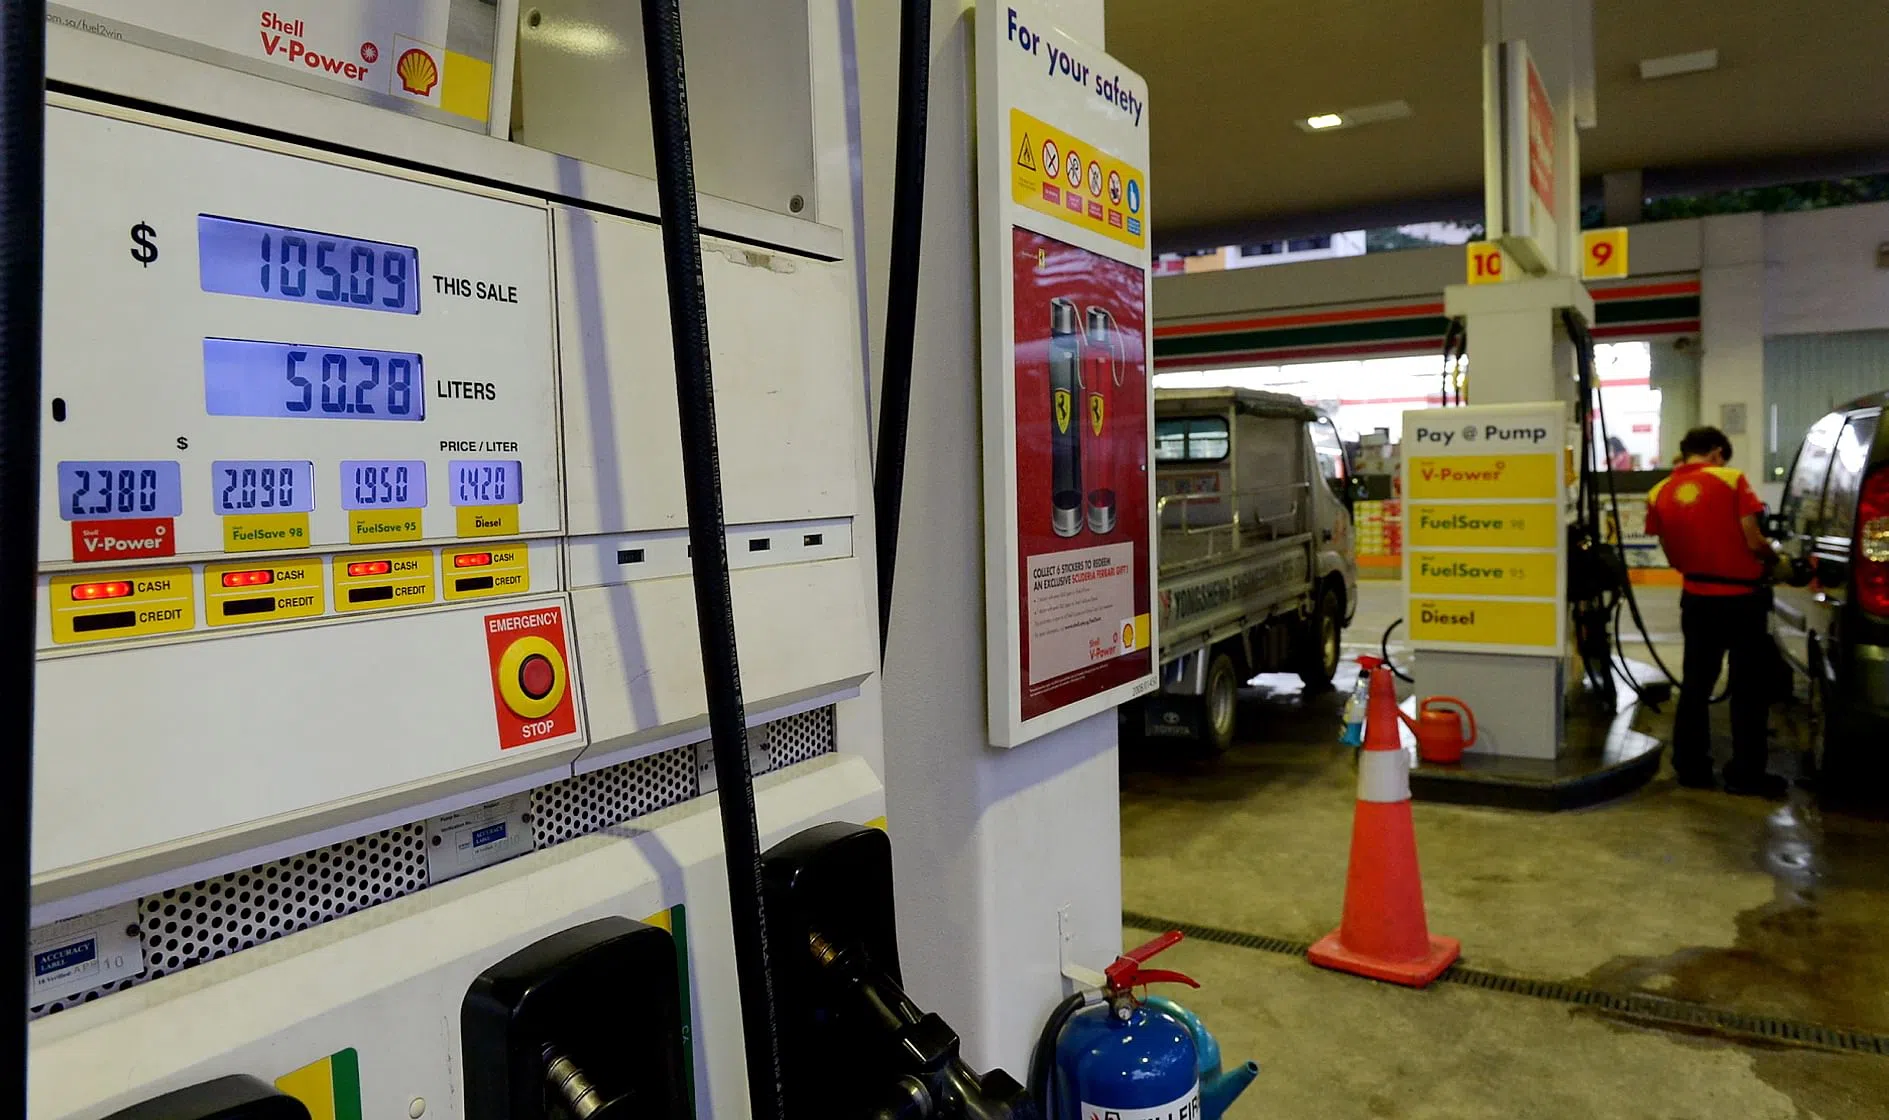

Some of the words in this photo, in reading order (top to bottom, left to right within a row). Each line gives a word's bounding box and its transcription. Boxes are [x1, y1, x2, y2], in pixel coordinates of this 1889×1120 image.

[260, 11, 304, 37] Shell
[260, 31, 369, 81] V-Power
[1007, 7, 1040, 56] For
[1046, 42, 1089, 86] your
[1095, 74, 1142, 127] safety
[130, 221, 158, 267] $
[1591, 242, 1614, 267] 9
[260, 232, 407, 309] 105.09
[1474, 252, 1502, 277] 10
[432, 275, 472, 298] THIS
[477, 281, 519, 304] SALE
[286, 350, 412, 415] 50.28
[436, 379, 497, 401] LITERS
[176, 436, 189, 451] $
[1417, 427, 1455, 446] Pay
[1463, 425, 1478, 441] @
[1485, 425, 1547, 444] Pump
[439, 440, 477, 452] PRICE
[478, 441, 484, 452] /
[485, 441, 519, 452] LITER
[460, 466, 505, 501] 1.420
[1421, 467, 1500, 482] V-Power
[72, 469, 157, 515] 2.380
[222, 467, 293, 510] 2.090
[355, 465, 408, 504] 1.950
[356, 522, 402, 534] FuelSave
[404, 522, 417, 532] 95
[475, 518, 502, 528] Diesel
[1420, 514, 1504, 530] FuelSave
[232, 529, 286, 541] FuelSave
[288, 527, 304, 538] 98
[83, 537, 163, 552] V-Power
[393, 561, 418, 572] CASH
[494, 553, 515, 563] CASH
[276, 570, 305, 581] CASH
[1033, 565, 1056, 580] COLLECT
[1061, 561, 1084, 575] STICKERS
[1084, 559, 1092, 570] TO
[1420, 563, 1504, 578] FuelSave
[137, 580, 171, 593] CASH
[494, 575, 522, 587] CREDIT
[1033, 580, 1043, 592] AN
[1043, 575, 1072, 590] EXCLUSIVE
[1072, 570, 1096, 584] SCUDERIA
[394, 585, 426, 597] CREDIT
[277, 596, 315, 609] CREDIT
[139, 609, 183, 623] CREDIT
[488, 611, 559, 633] EMERGENCY
[1421, 609, 1475, 625] Diesel
[521, 719, 555, 738] STOP
[41, 942, 90, 963] ACCURACY
[41, 960, 66, 971] LABEL
